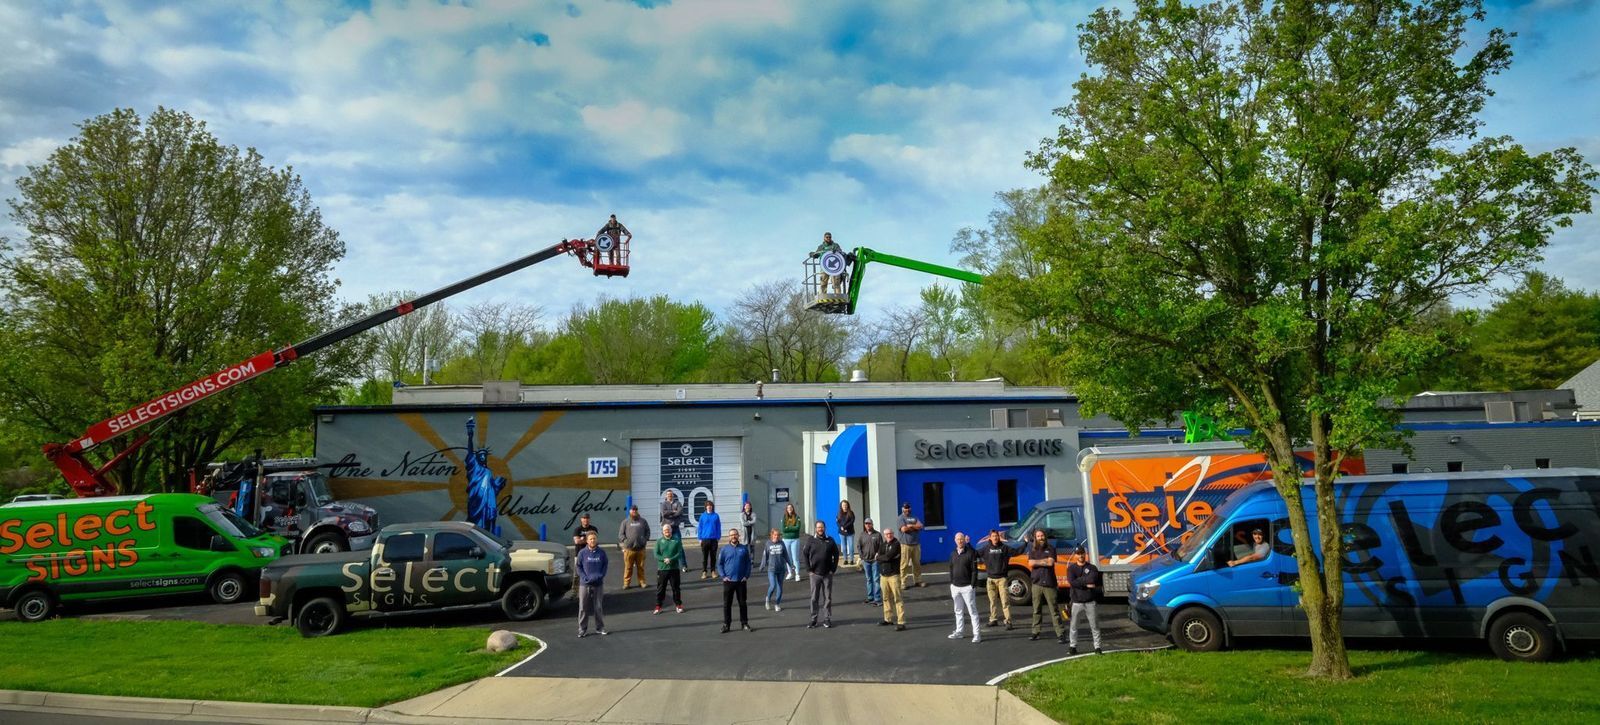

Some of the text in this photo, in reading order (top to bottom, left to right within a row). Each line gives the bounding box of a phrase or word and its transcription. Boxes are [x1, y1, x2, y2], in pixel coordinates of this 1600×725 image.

[108, 361, 256, 433] SELECTSIGNS.COM
[914, 438, 1064, 460] Select SIGNS
[381, 447, 468, 477] Nation
[590, 460, 616, 475] 1755
[668, 456, 705, 466] Select
[497, 495, 560, 517] Under
[0, 501, 156, 553] Select
[25, 539, 138, 582] SIGNS
[130, 577, 199, 588] selectsigns.com
[341, 561, 501, 592] Select
[353, 592, 429, 605] SIGNS
